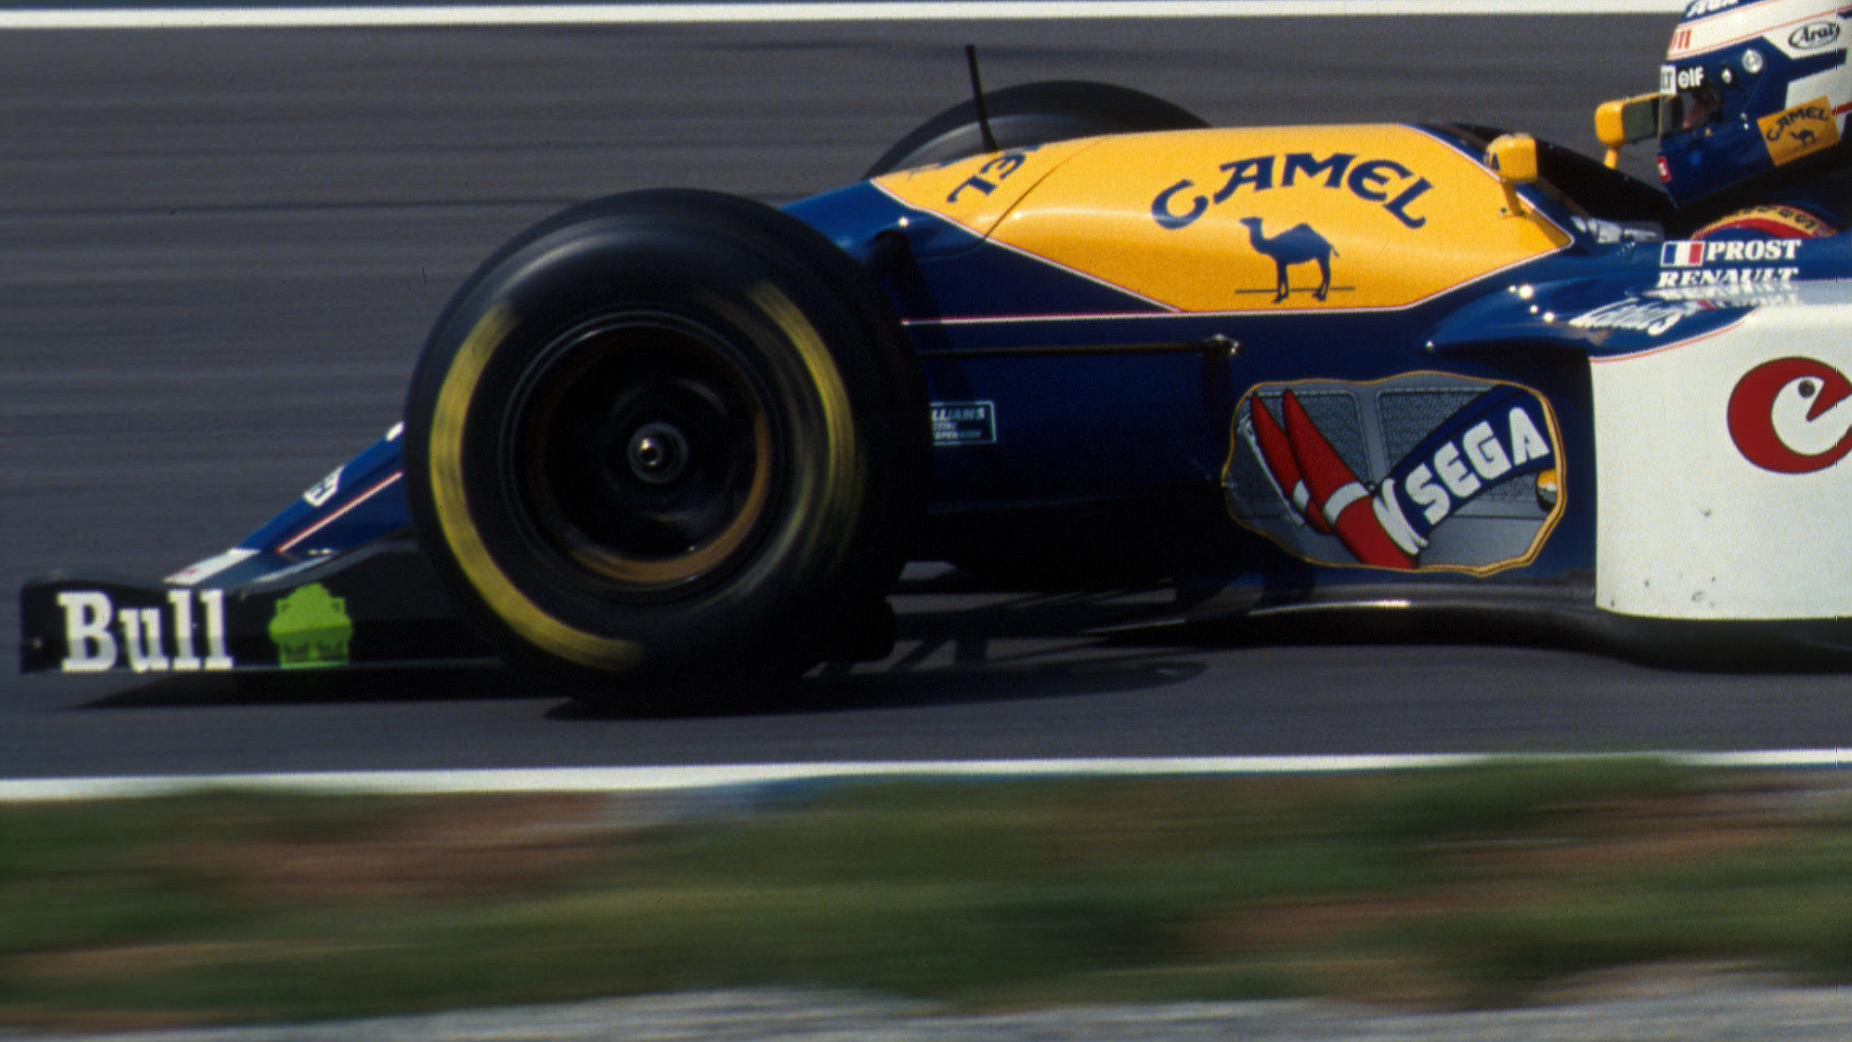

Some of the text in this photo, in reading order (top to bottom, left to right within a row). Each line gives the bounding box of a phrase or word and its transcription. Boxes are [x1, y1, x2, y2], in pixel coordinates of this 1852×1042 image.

[1678, 66, 1705, 89] elf
[1151, 152, 1434, 231] CAMEL
[1706, 239, 1802, 261] PROST
[1655, 267, 1799, 289] RENAULT
[1405, 406, 1550, 527] SEGA
[57, 588, 234, 674] Bull
